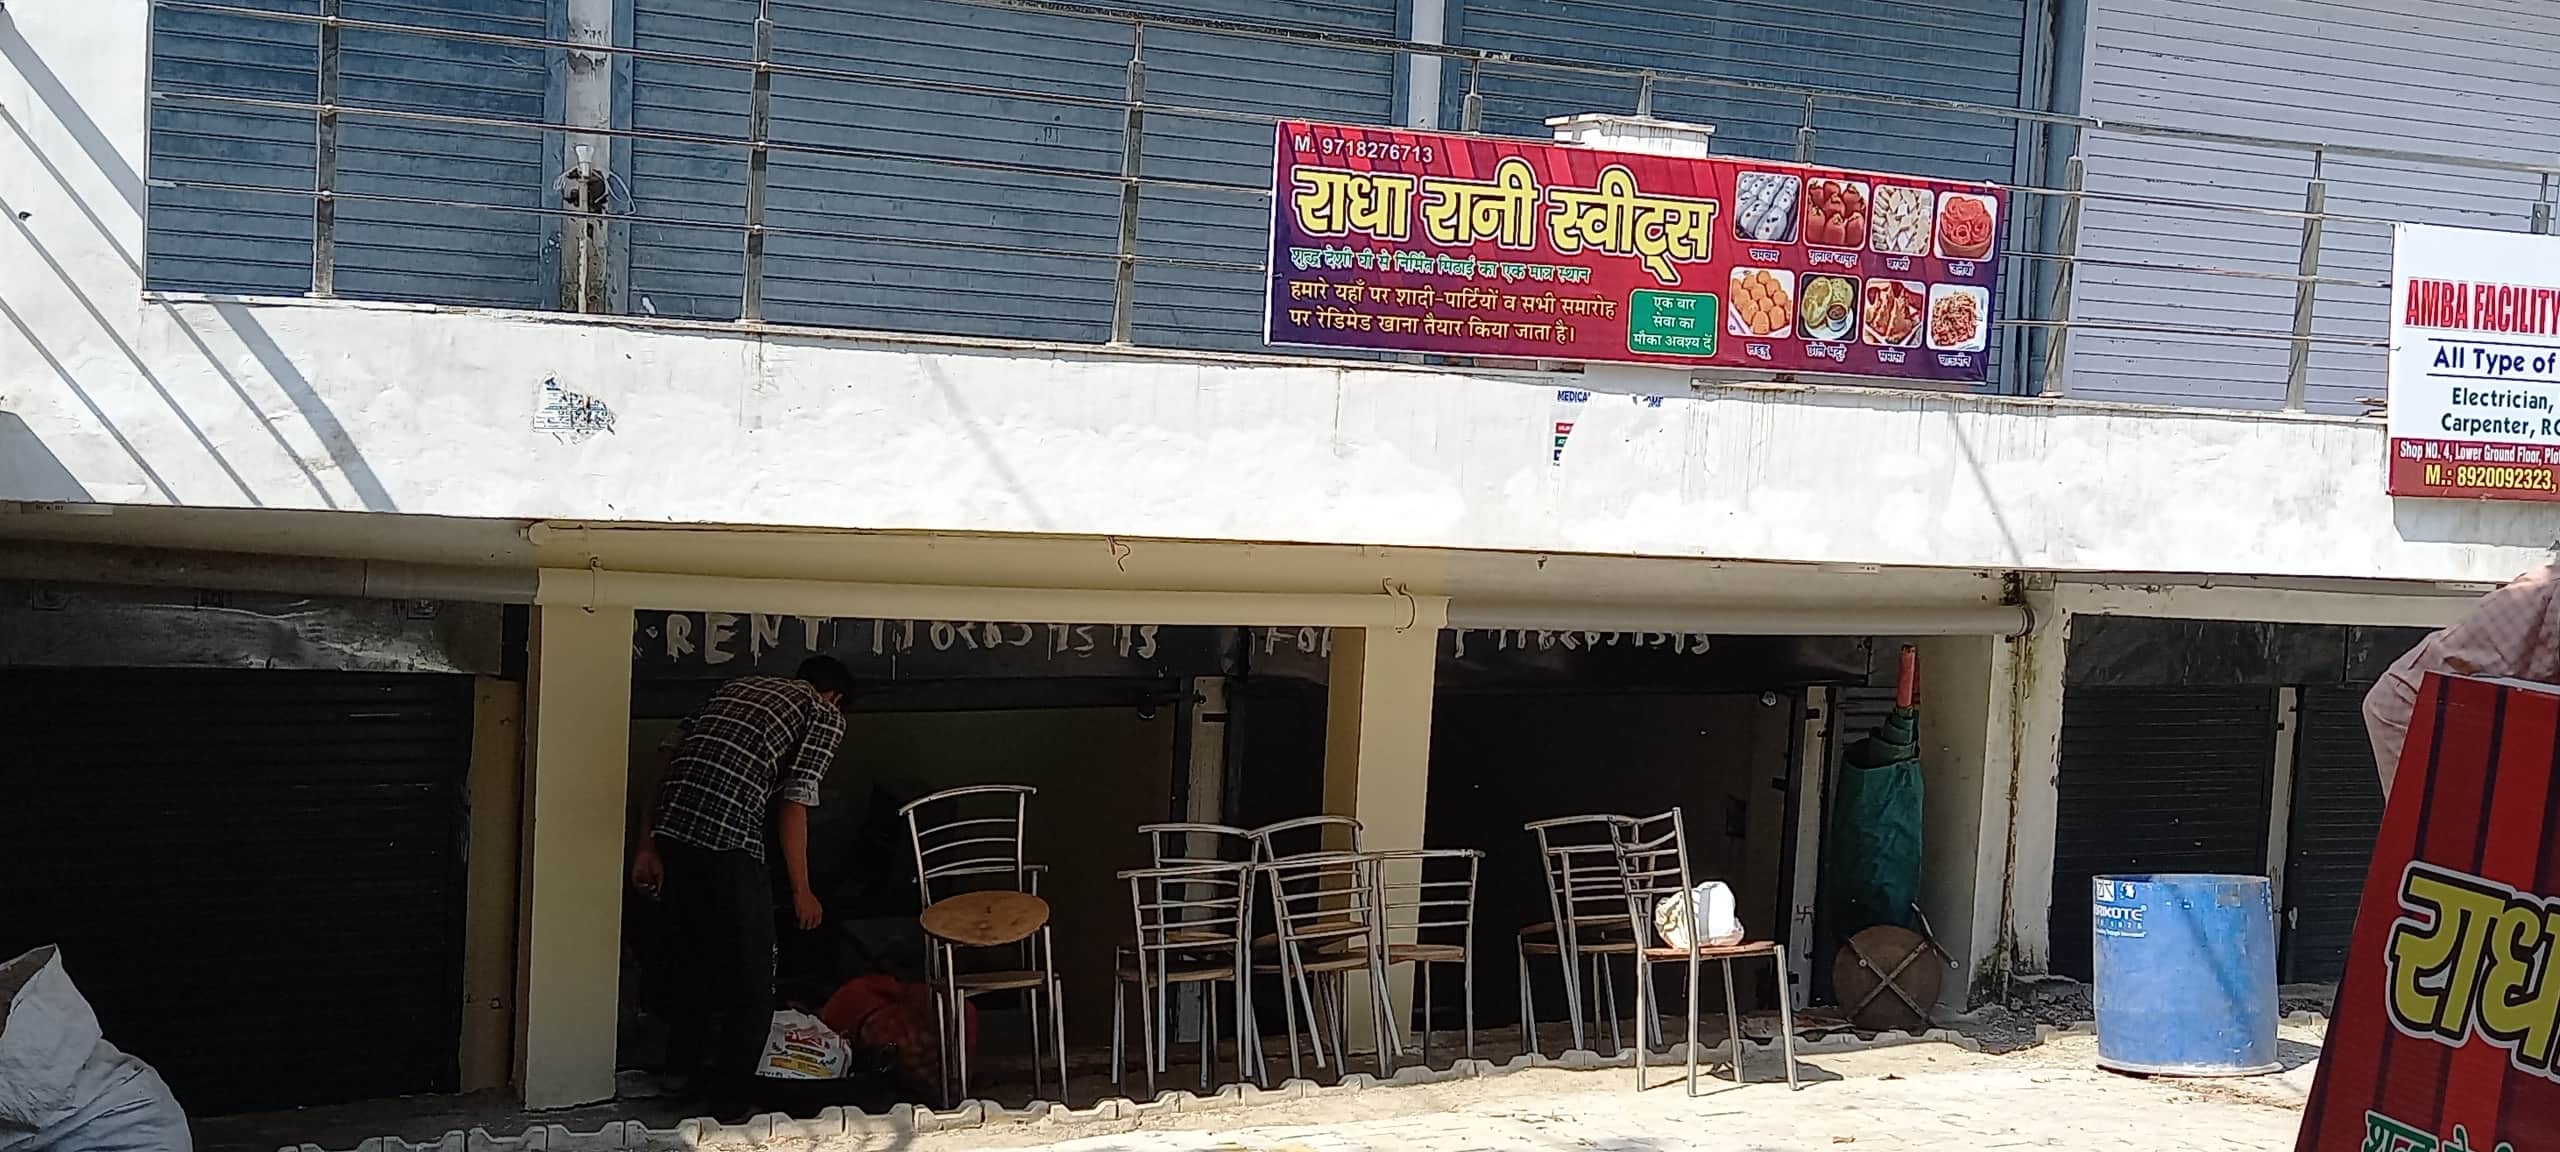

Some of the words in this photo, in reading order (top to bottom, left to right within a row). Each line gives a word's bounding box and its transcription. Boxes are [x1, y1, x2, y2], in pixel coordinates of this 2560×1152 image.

[1295, 135, 1315, 152] M.
[1323, 138, 1433, 163] 9718276713
[1292, 166, 1416, 241] राधा
[1420, 158, 1541, 249] रानी
[1546, 165, 1718, 284] स्वीट्स
[1324, 244, 1353, 269] देशी
[1357, 247, 1374, 270] घी
[1378, 249, 1391, 271] से
[1394, 250, 1434, 274] निर्मित
[1437, 253, 1476, 280] मिठाई
[1478, 260, 1497, 278] का
[1501, 262, 1526, 283] एक
[1528, 263, 1554, 281] मात्र
[1557, 265, 1591, 284] स्थान
[1290, 276, 1329, 300] हमारे
[1334, 279, 1365, 303] यहाँ
[1369, 286, 1391, 304] पर
[1503, 295, 1517, 312] व
[1521, 292, 1556, 314] सभी
[1560, 295, 1617, 319] समारोह
[1653, 296, 1674, 311] एक
[1676, 298, 1696, 310] बार
[2405, 279, 2468, 329] AMBA
[2473, 284, 2560, 335] FACILITY
[1289, 309, 1312, 327] पर
[1316, 305, 1372, 331] रेडिमेड
[1376, 315, 1419, 334] खाना
[1424, 312, 1464, 336] तैयार
[1468, 315, 1510, 339] किया
[1513, 324, 1551, 341] जाता
[1652, 311, 1676, 328] सेवा
[1678, 317, 1695, 329] का
[1632, 330, 1662, 345] मौका
[1665, 335, 1700, 349] अवश्य
[1702, 333, 1713, 351] दें
[2433, 345, 2464, 368] All
[2473, 348, 2525, 375] Type
[2532, 352, 2556, 374] of
[1557, 390, 1591, 403] MEDICA
[2452, 387, 2554, 414] Electrician,
[2441, 412, 2535, 439] Carpenter,
[2400, 441, 2423, 462] Shop
[2425, 442, 2441, 459] NO.
[2455, 444, 2482, 461] Lower
[2484, 445, 2515, 462] Ground
[2517, 446, 2542, 466] Floor,
[2545, 447, 2560, 465] Plo
[2456, 466, 2557, 493] 8920092323,
[667, 613, 830, 665] RENT
[2386, 861, 2560, 1083] राध
